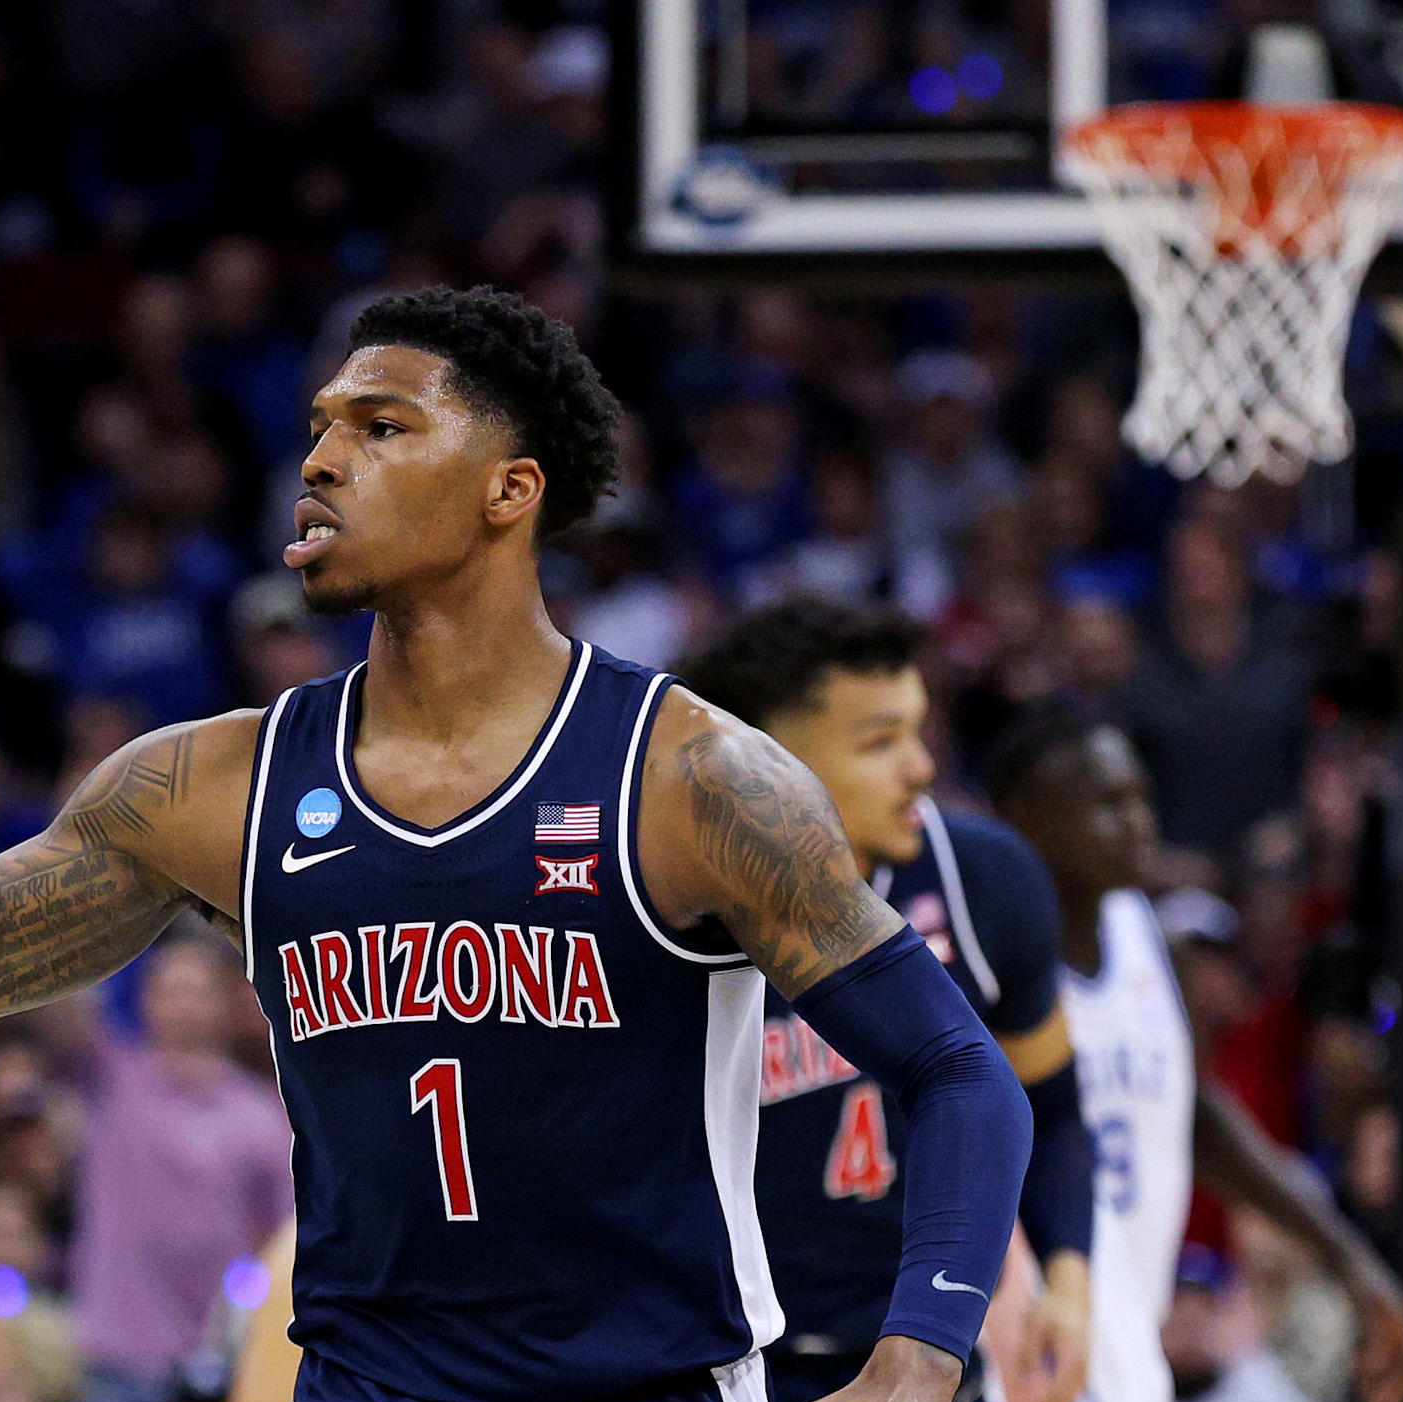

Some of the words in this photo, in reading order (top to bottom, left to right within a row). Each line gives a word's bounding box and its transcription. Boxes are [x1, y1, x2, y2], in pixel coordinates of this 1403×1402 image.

[300, 810, 338, 825] NCAA
[538, 858, 595, 892] XII
[278, 920, 621, 1042] ARIZONA
[409, 1058, 479, 1221] 1
[823, 1081, 897, 1200] 4
